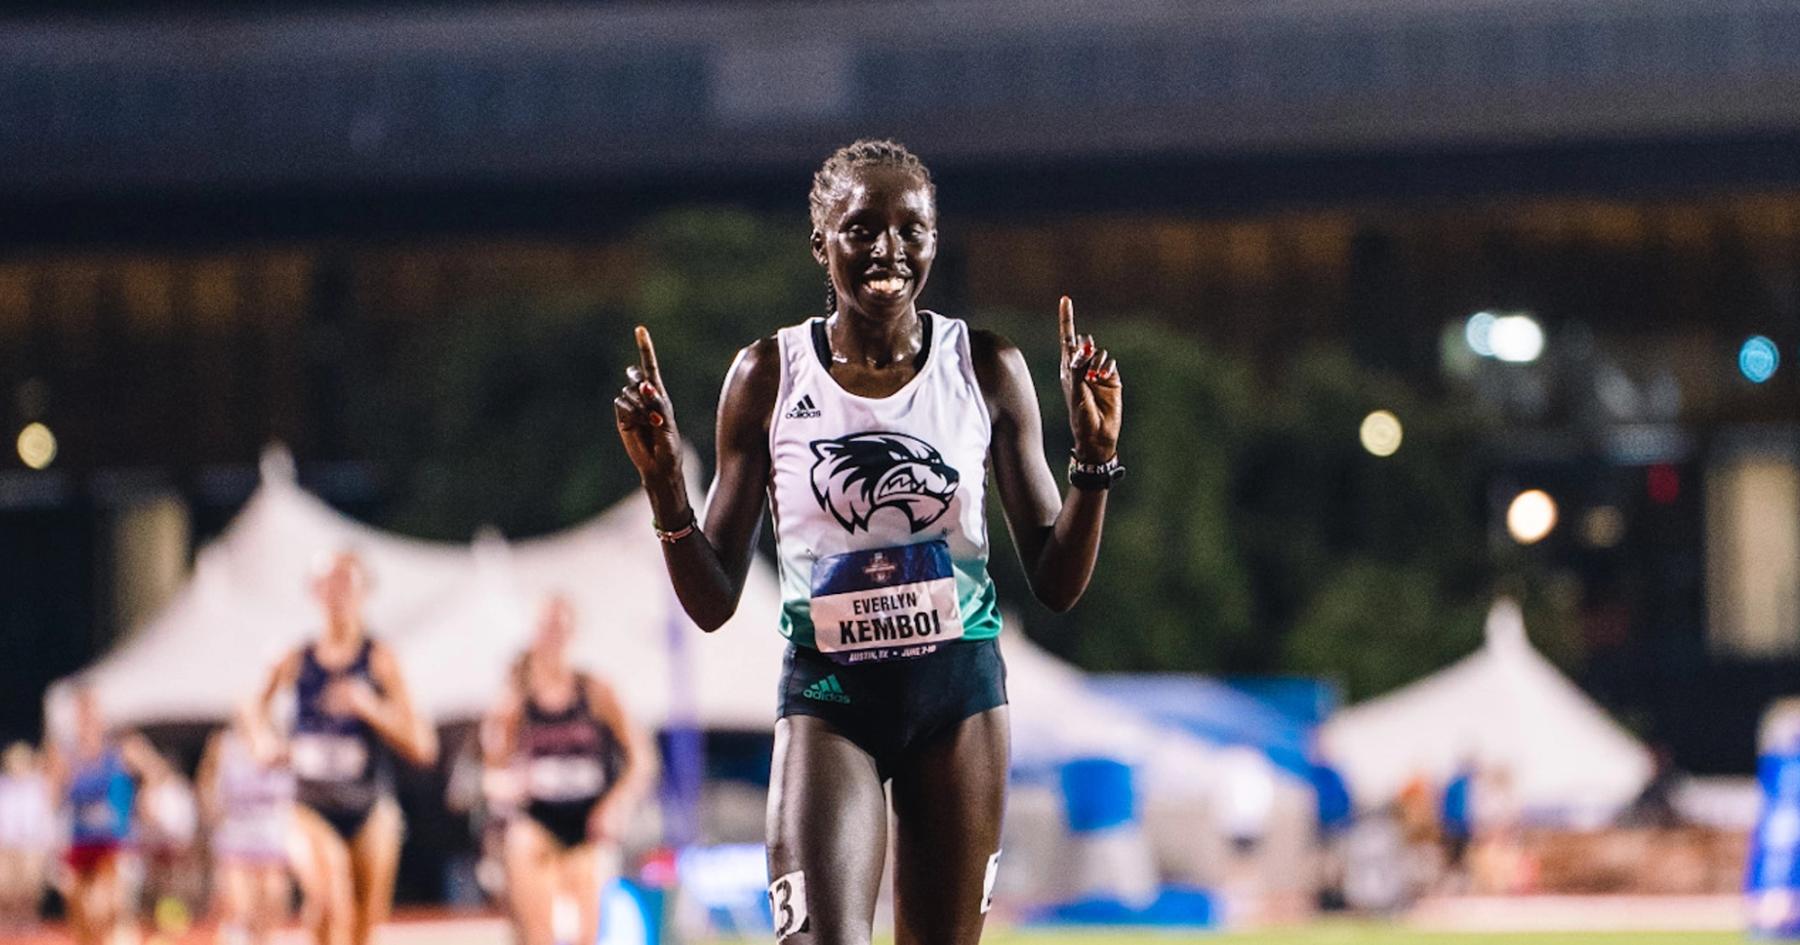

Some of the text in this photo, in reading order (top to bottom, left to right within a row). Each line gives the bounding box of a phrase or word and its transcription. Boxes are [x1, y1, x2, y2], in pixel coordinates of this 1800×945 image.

[785, 409, 821, 419] adidas
[853, 592, 917, 615] EVERLYN
[839, 609, 941, 645] KEMBOI
[803, 689, 850, 704] adidas
